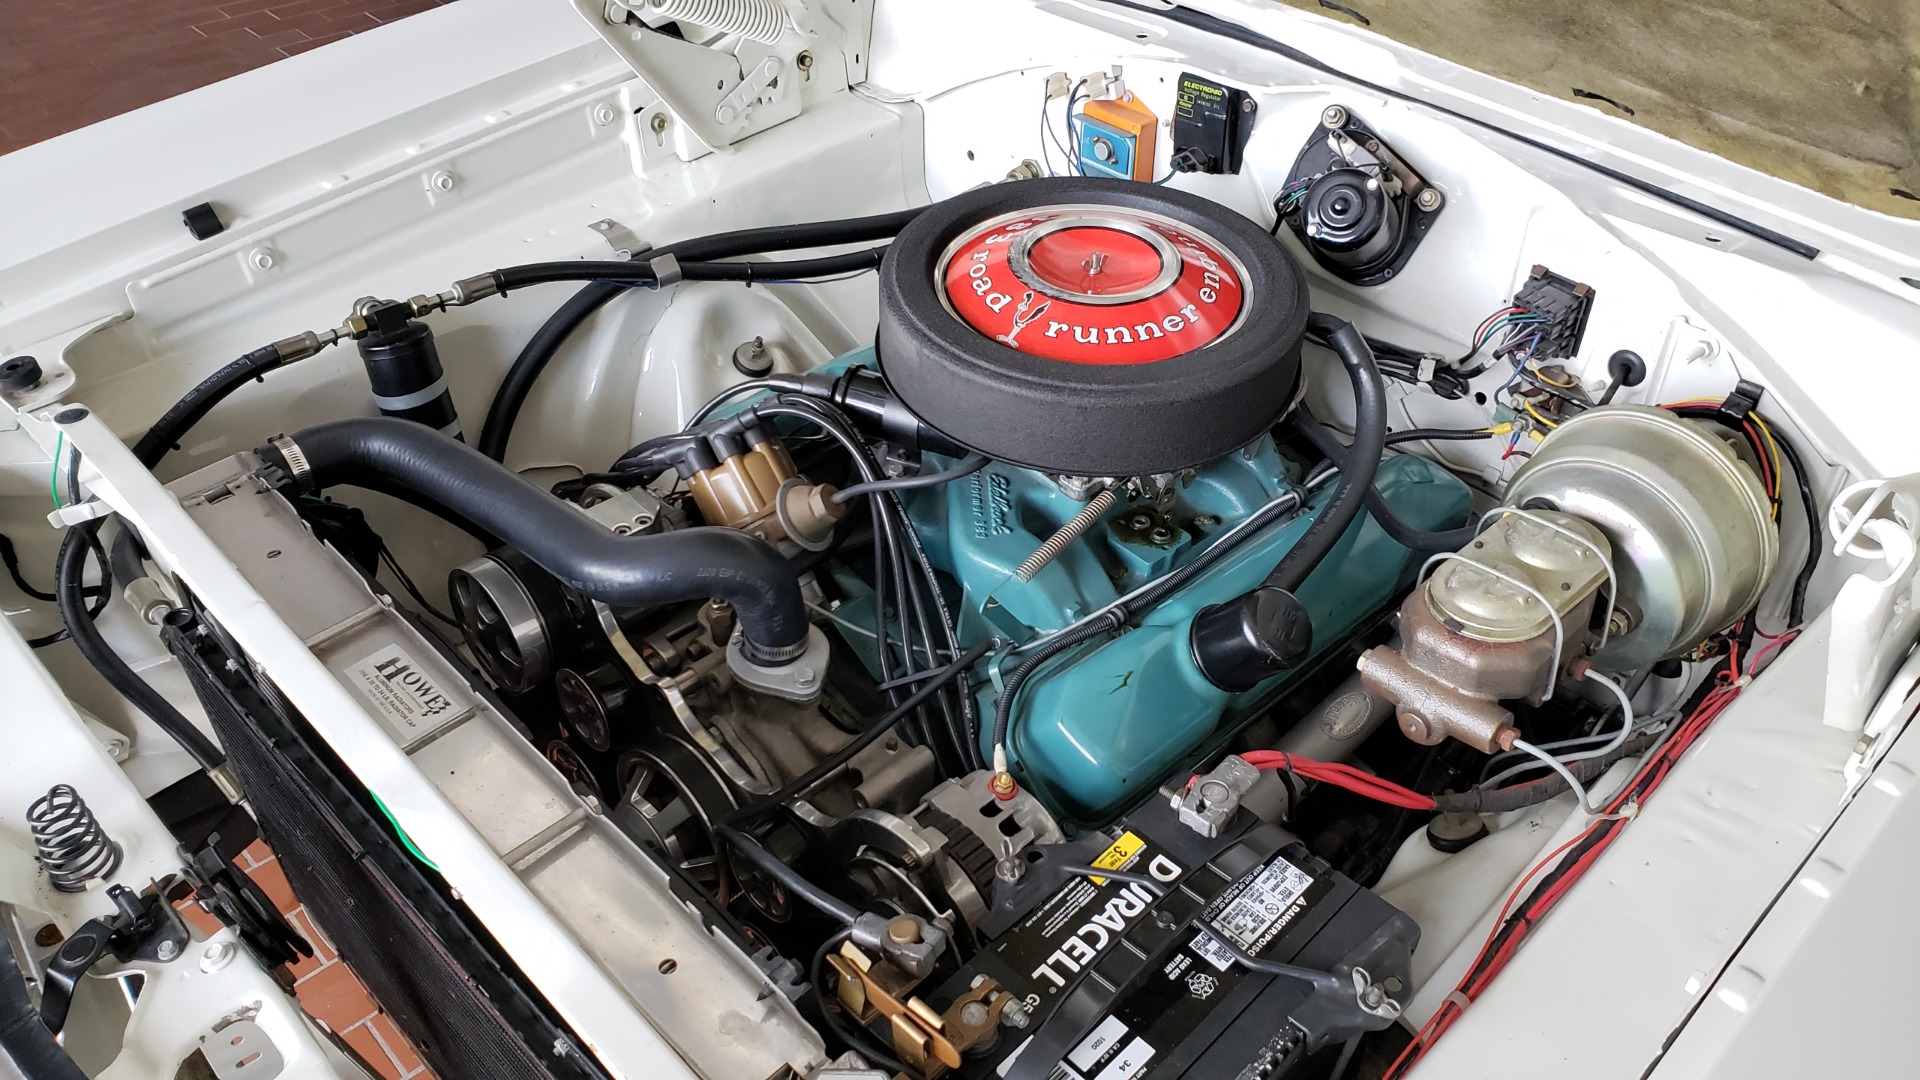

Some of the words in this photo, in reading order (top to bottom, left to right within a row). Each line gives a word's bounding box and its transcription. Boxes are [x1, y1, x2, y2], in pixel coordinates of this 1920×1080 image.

[969, 248, 1013, 314] road
[1043, 303, 1200, 345] runner
[374, 656, 451, 716] HOWE
[391, 693, 415, 714] RADIATORS
[387, 701, 409, 720] RADIATOR
[405, 719, 417, 728] CAP
[1113, 845, 1128, 857] 3
[1109, 856, 1122, 867] Year
[1252, 864, 1265, 876] KEEP
[1243, 874, 1254, 884] OUT
[1223, 888, 1240, 904] REACH
[1245, 904, 1301, 957] DANGER/POISO
[1164, 953, 1185, 974] BATTERY
[1178, 956, 1193, 970] LEAD
[1168, 967, 1181, 981] ACID
[1091, 1036, 1106, 1050] 1020
[1119, 1059, 1132, 1072] 34
